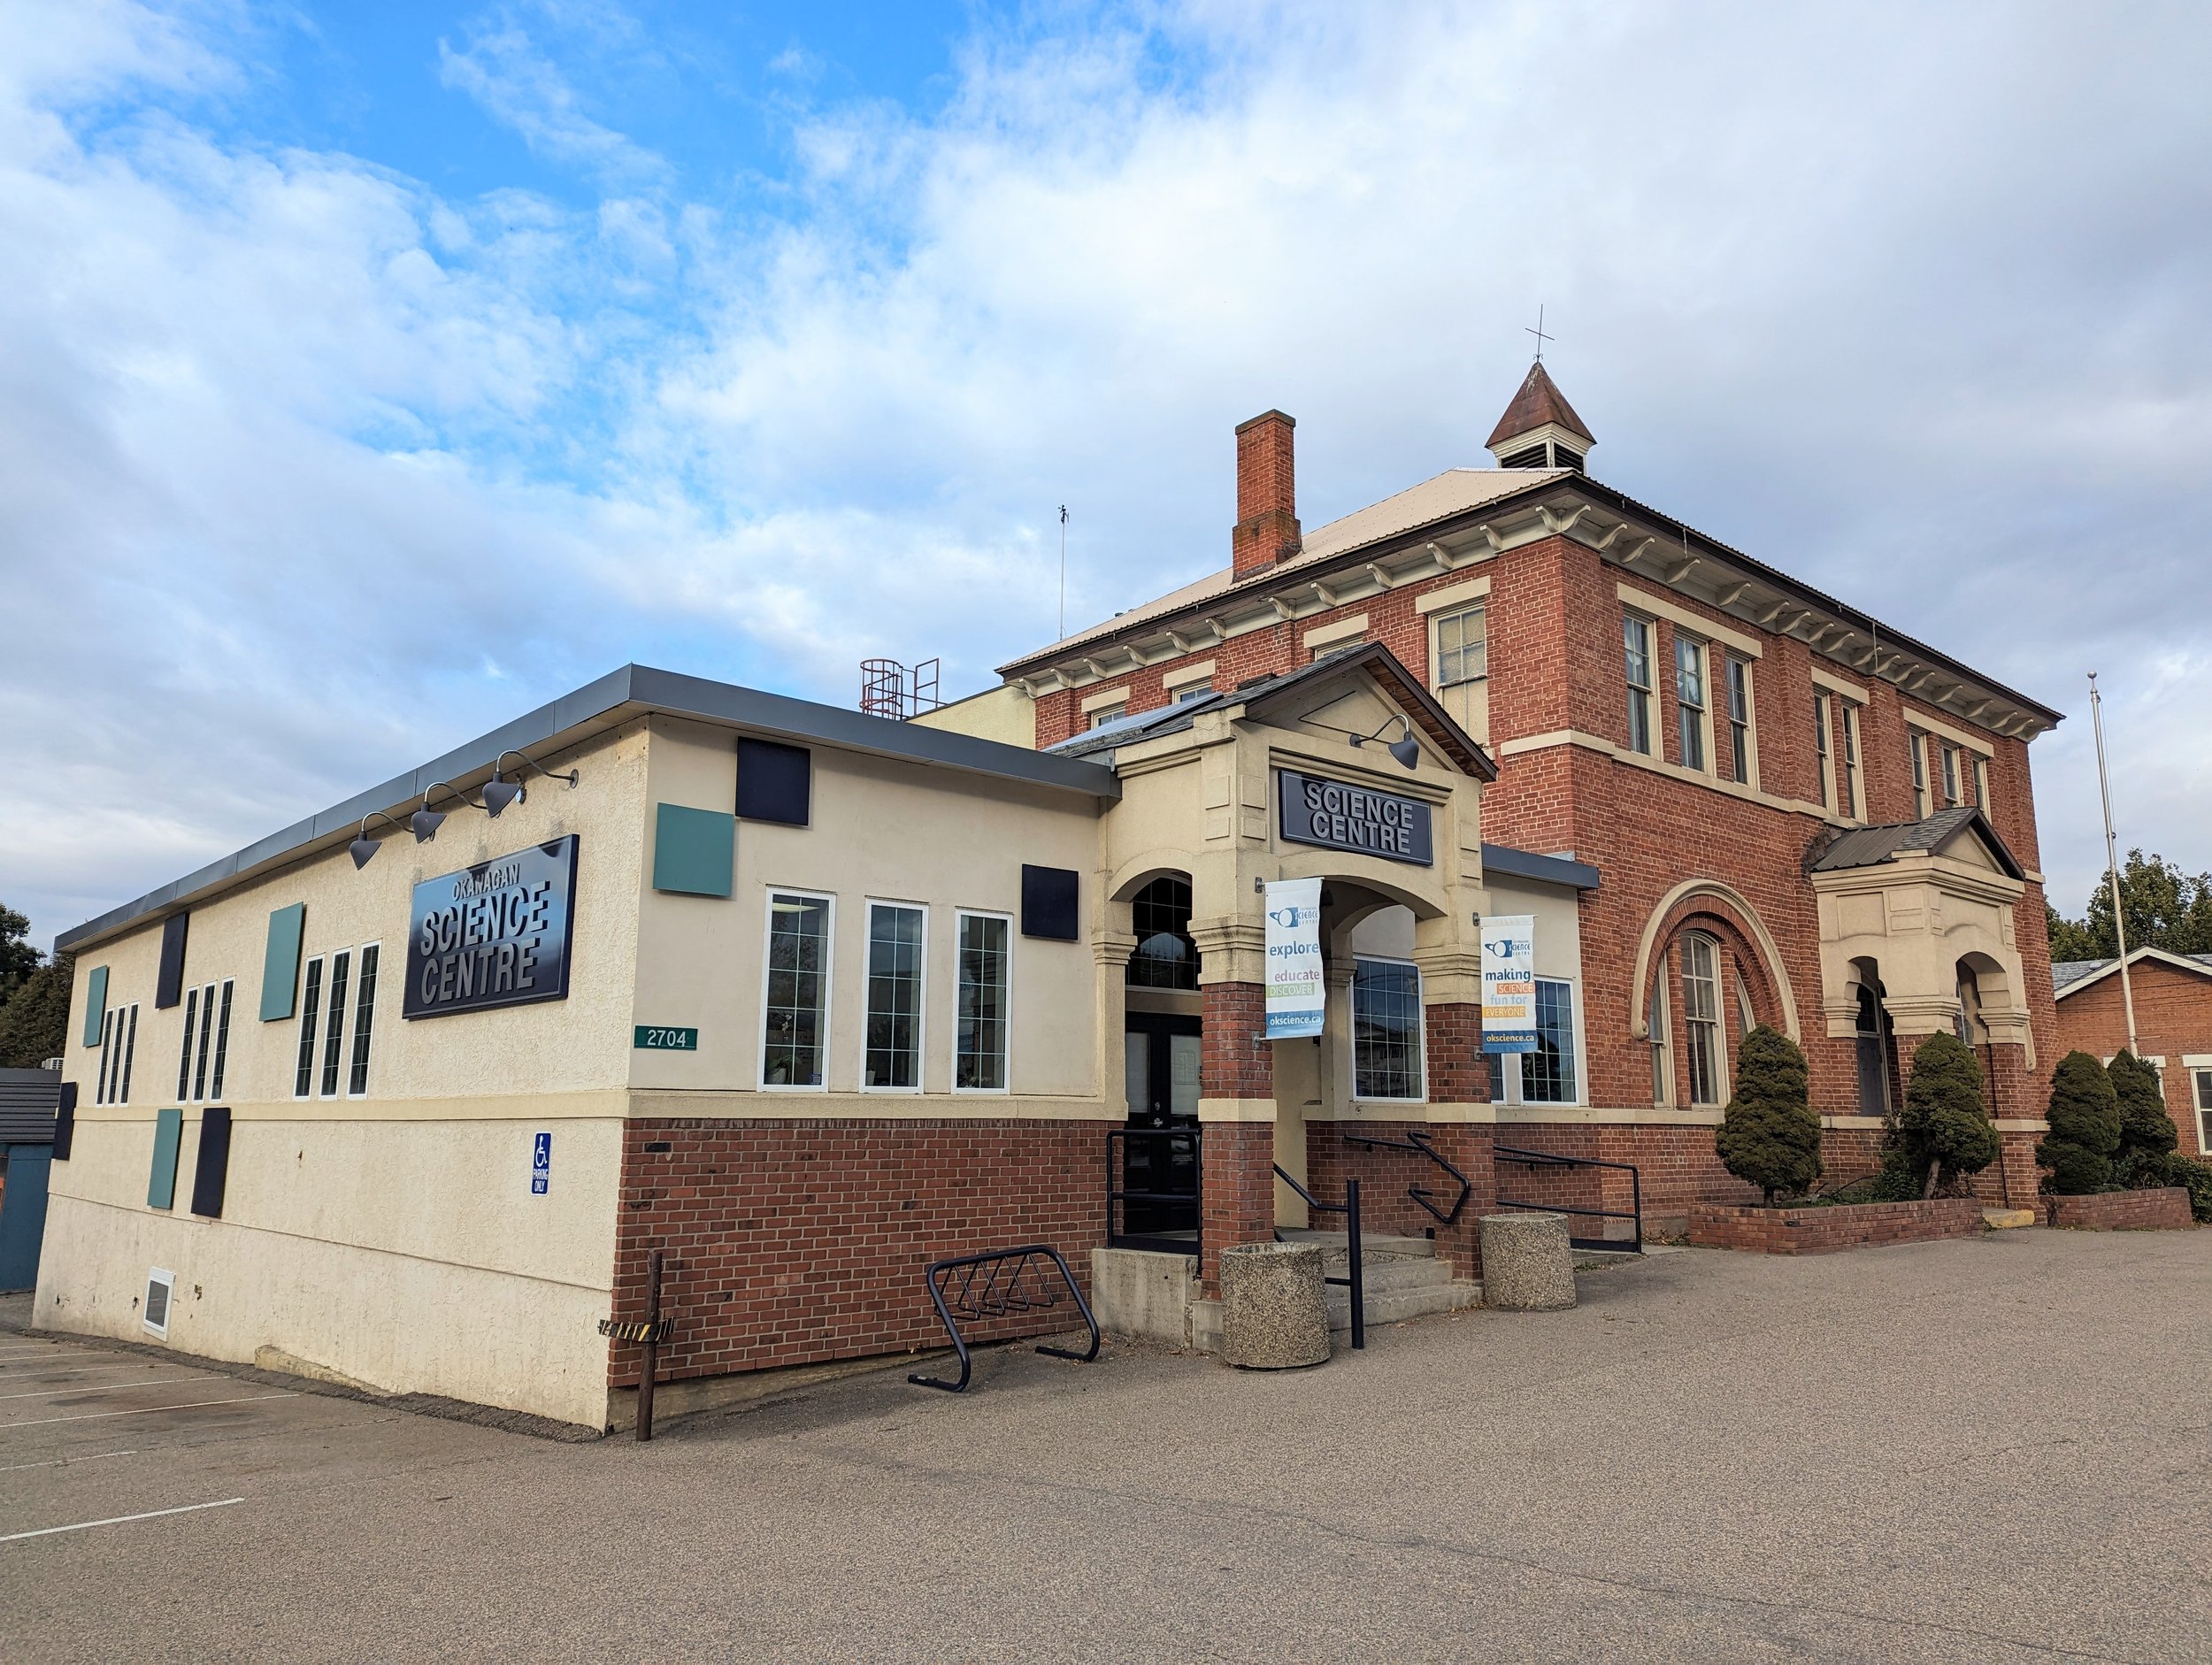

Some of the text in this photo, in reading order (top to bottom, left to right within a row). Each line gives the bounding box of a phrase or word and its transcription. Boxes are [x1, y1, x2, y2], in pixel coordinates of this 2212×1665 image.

[1305, 783, 1414, 829] SCIENCE
[1311, 810, 1411, 854] CENTRE
[452, 863, 520, 902] OKANAGAN
[420, 879, 549, 956] SCIENCE
[1294, 910, 1318, 920] SCIENCE
[1269, 940, 1319, 959] explore
[420, 937, 540, 1005] CENTRE
[1274, 970, 1320, 983] educate
[1486, 968, 1531, 983] making
[1269, 984, 1314, 997] DISCOVER
[1498, 983, 1533, 994] SCIENCE
[1490, 994, 1527, 1005] fun for
[1486, 1007, 1525, 1017] EVERYONE
[1270, 1015, 1321, 1026] okscience.ca
[647, 1029, 687, 1047] 2704
[1486, 1033, 1535, 1043] okscience.ca
